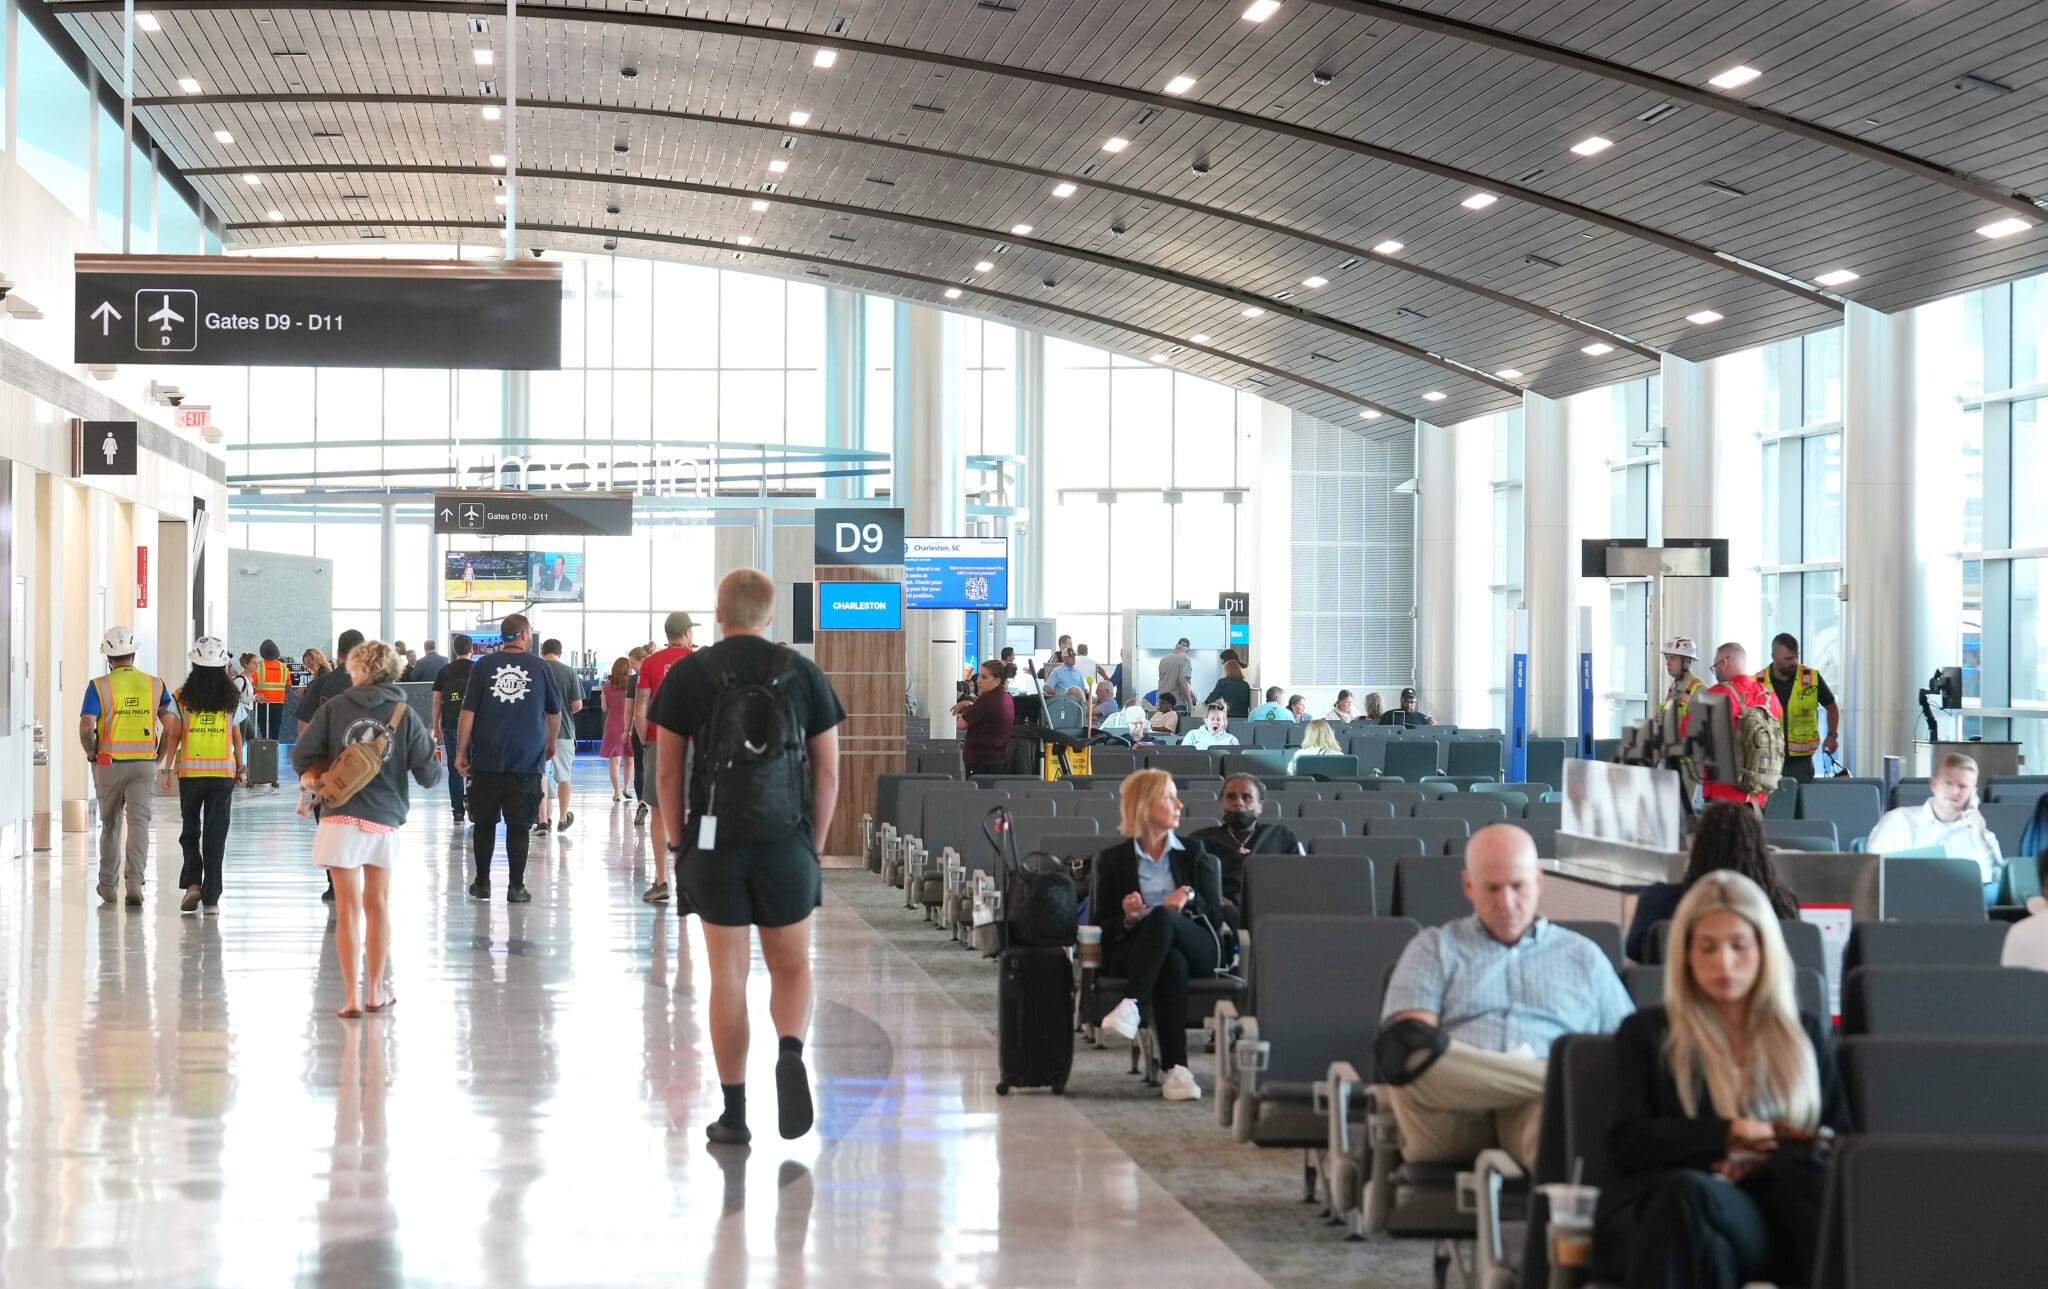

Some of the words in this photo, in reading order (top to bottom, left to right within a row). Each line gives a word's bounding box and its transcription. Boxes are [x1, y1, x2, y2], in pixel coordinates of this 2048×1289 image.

[205, 312, 260, 330] Gates
[265, 313, 291, 330] D9
[308, 314, 343, 331] D11
[161, 336, 171, 346] D
[185, 411, 207, 427] EXIT
[487, 512, 511, 521] Gates
[533, 513, 549, 521] D11
[835, 522, 884, 554] D9
[914, 544, 951, 552] Charleston,
[951, 544, 960, 552] SC
[832, 602, 887, 610] CHARLESTON
[1225, 598, 1244, 612] D11
